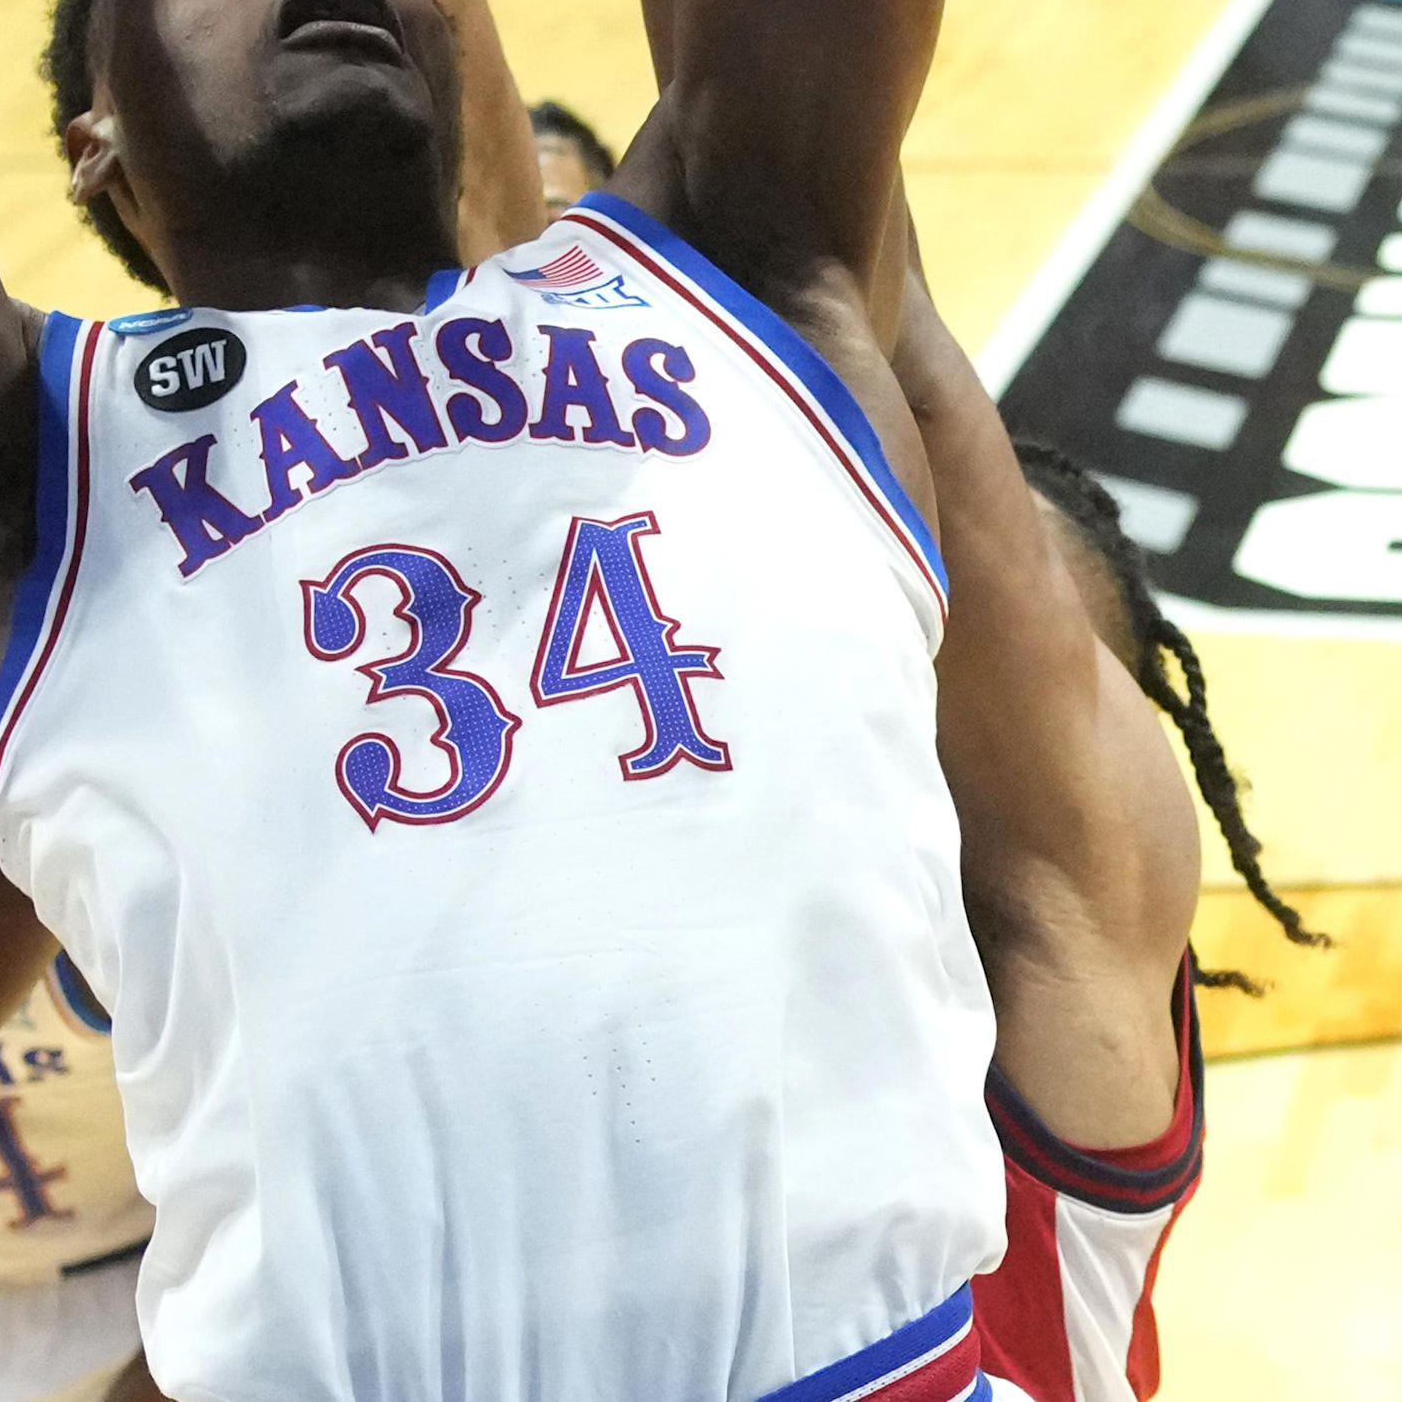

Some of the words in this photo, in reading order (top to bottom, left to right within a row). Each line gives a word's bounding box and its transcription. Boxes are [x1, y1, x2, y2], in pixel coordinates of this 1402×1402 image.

[129, 316, 712, 580] KANSAS
[149, 339, 227, 397] SW
[297, 509, 733, 832] 34
